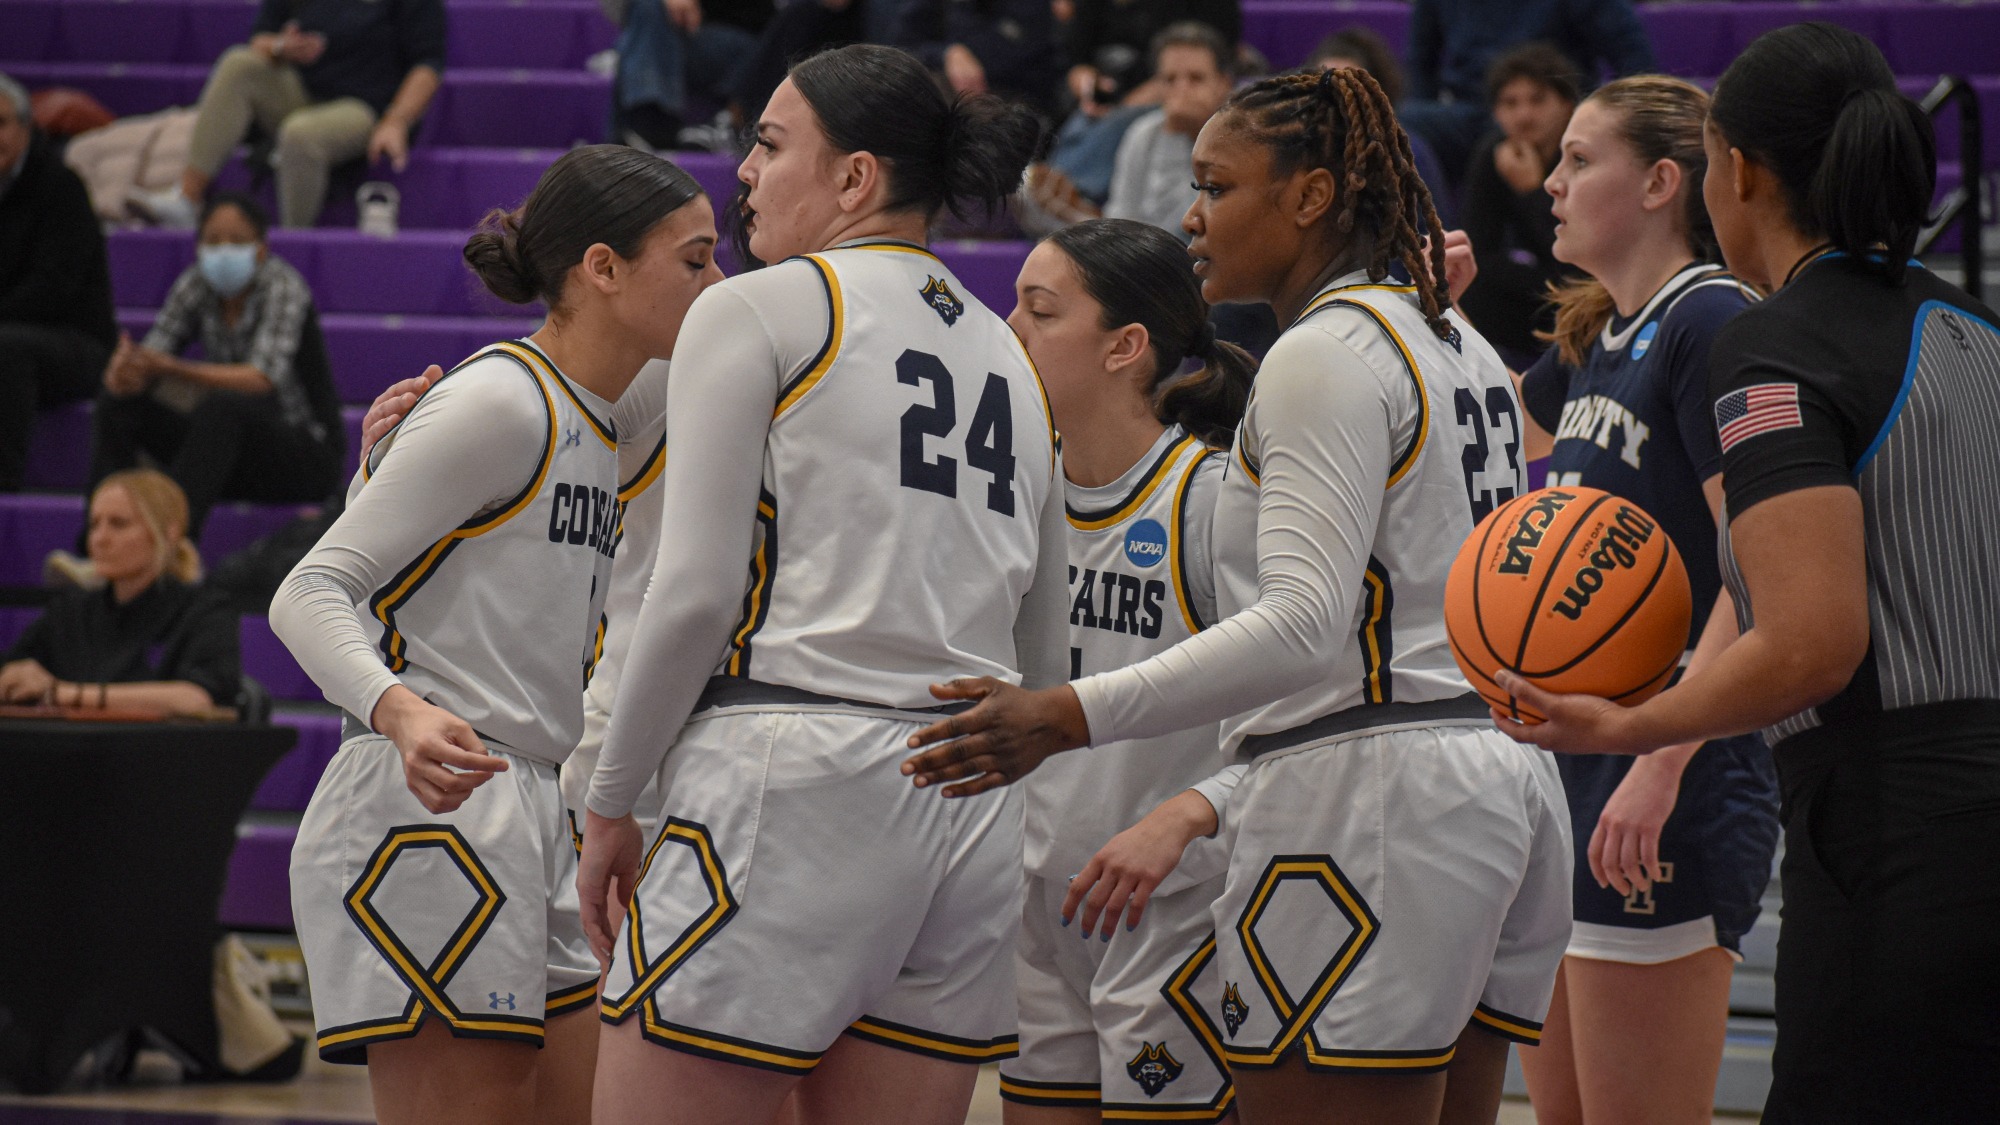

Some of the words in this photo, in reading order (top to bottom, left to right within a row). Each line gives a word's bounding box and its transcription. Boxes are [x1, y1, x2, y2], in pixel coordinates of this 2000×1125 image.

[895, 348, 1016, 518] 24
[1453, 386, 1520, 528] 23
[1128, 540, 1164, 556] NCAA
[1497, 490, 1577, 575] NCAA
[1551, 505, 1656, 621] Wilson
[1577, 539, 1594, 560] NXT
[1590, 521, 1605, 540] EVO
[1069, 566, 1166, 640] AIRS
